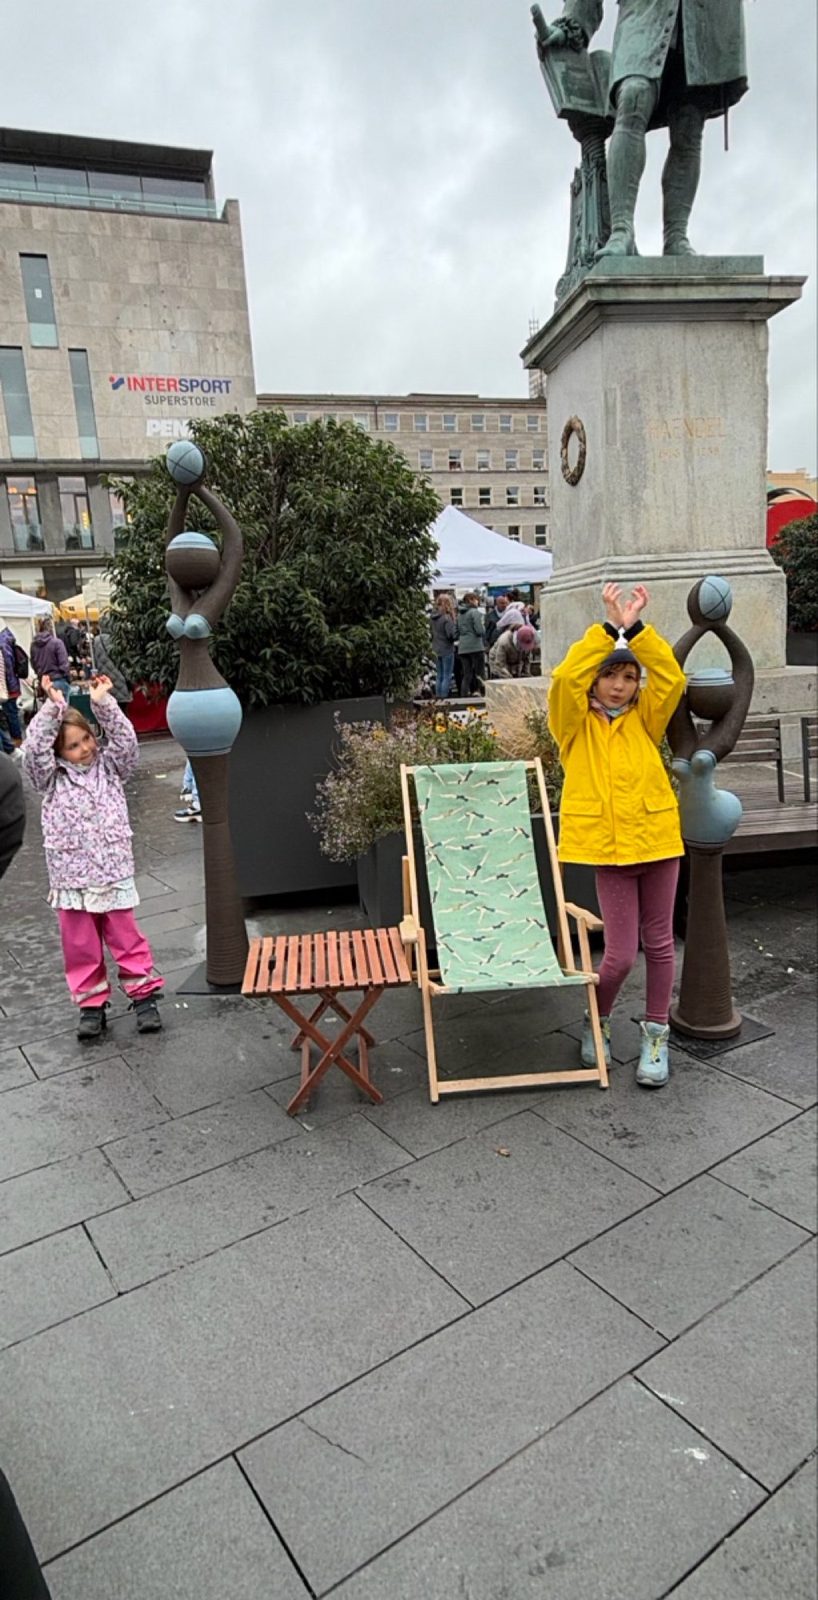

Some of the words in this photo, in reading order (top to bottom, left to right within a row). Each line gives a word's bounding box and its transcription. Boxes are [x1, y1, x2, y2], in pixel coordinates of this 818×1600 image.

[127, 376, 232, 393] INTERSPORT
[144, 395, 216, 406] SUPERSTORE
[146, 419, 192, 437] PEN
